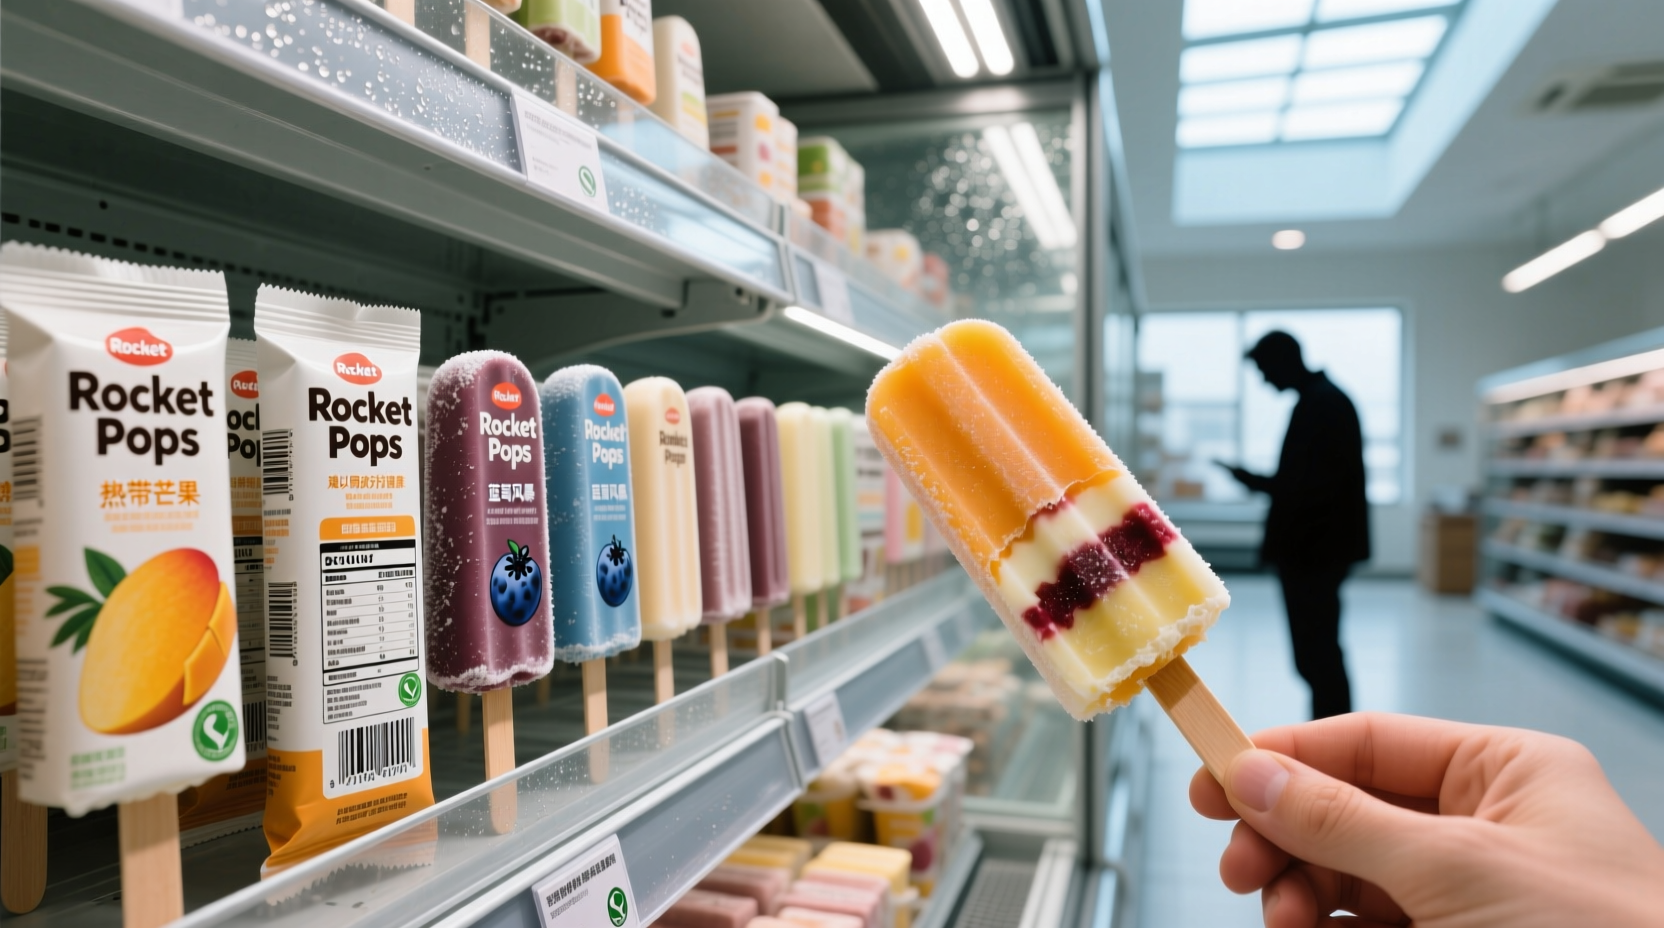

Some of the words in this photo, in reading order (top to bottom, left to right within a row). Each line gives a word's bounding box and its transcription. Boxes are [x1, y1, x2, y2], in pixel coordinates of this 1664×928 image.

[109, 337, 168, 357] Rocket
[70, 371, 214, 417] Rocket
[308, 387, 412, 427] Rocket
[479, 411, 537, 439] Rocket
[97, 418, 200, 466] Pops
[329, 425, 403, 467] Pops
[488, 437, 532, 470] Pops
[592, 442, 624, 470] Pops
[99, 479, 201, 509] 热带芒果
